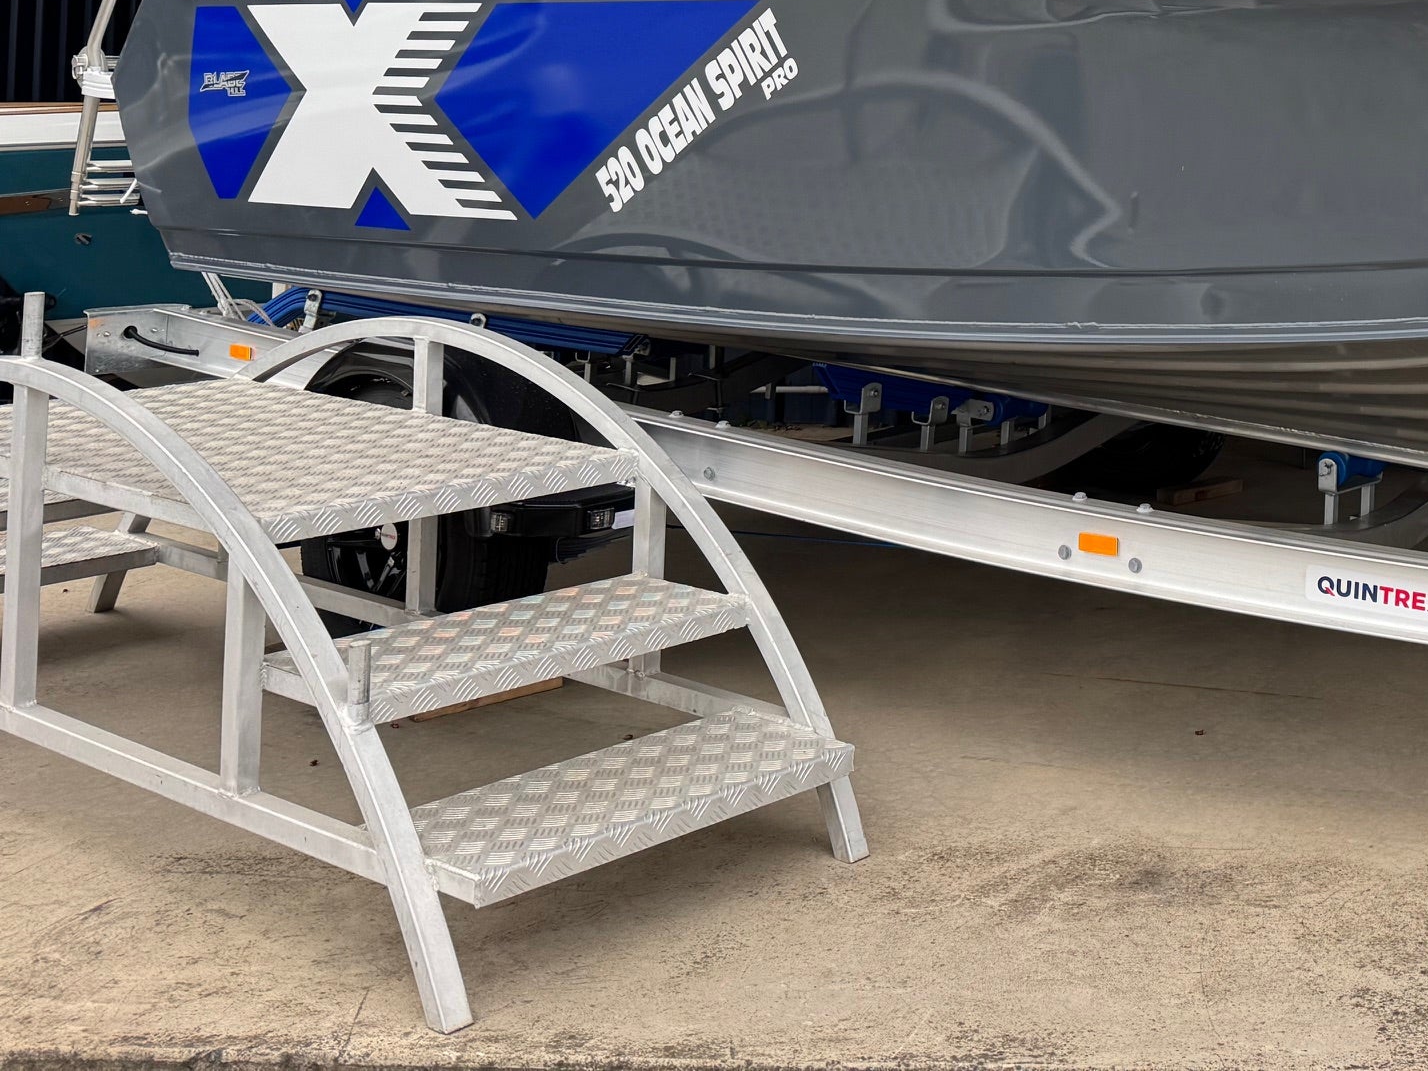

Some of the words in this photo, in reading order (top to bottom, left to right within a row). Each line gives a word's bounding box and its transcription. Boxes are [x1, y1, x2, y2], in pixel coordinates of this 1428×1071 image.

[595, 146, 645, 213] 520
[635, 77, 716, 175] OCEAN
[704, 7, 788, 111] SPIRIT
[761, 57, 799, 100] PRO
